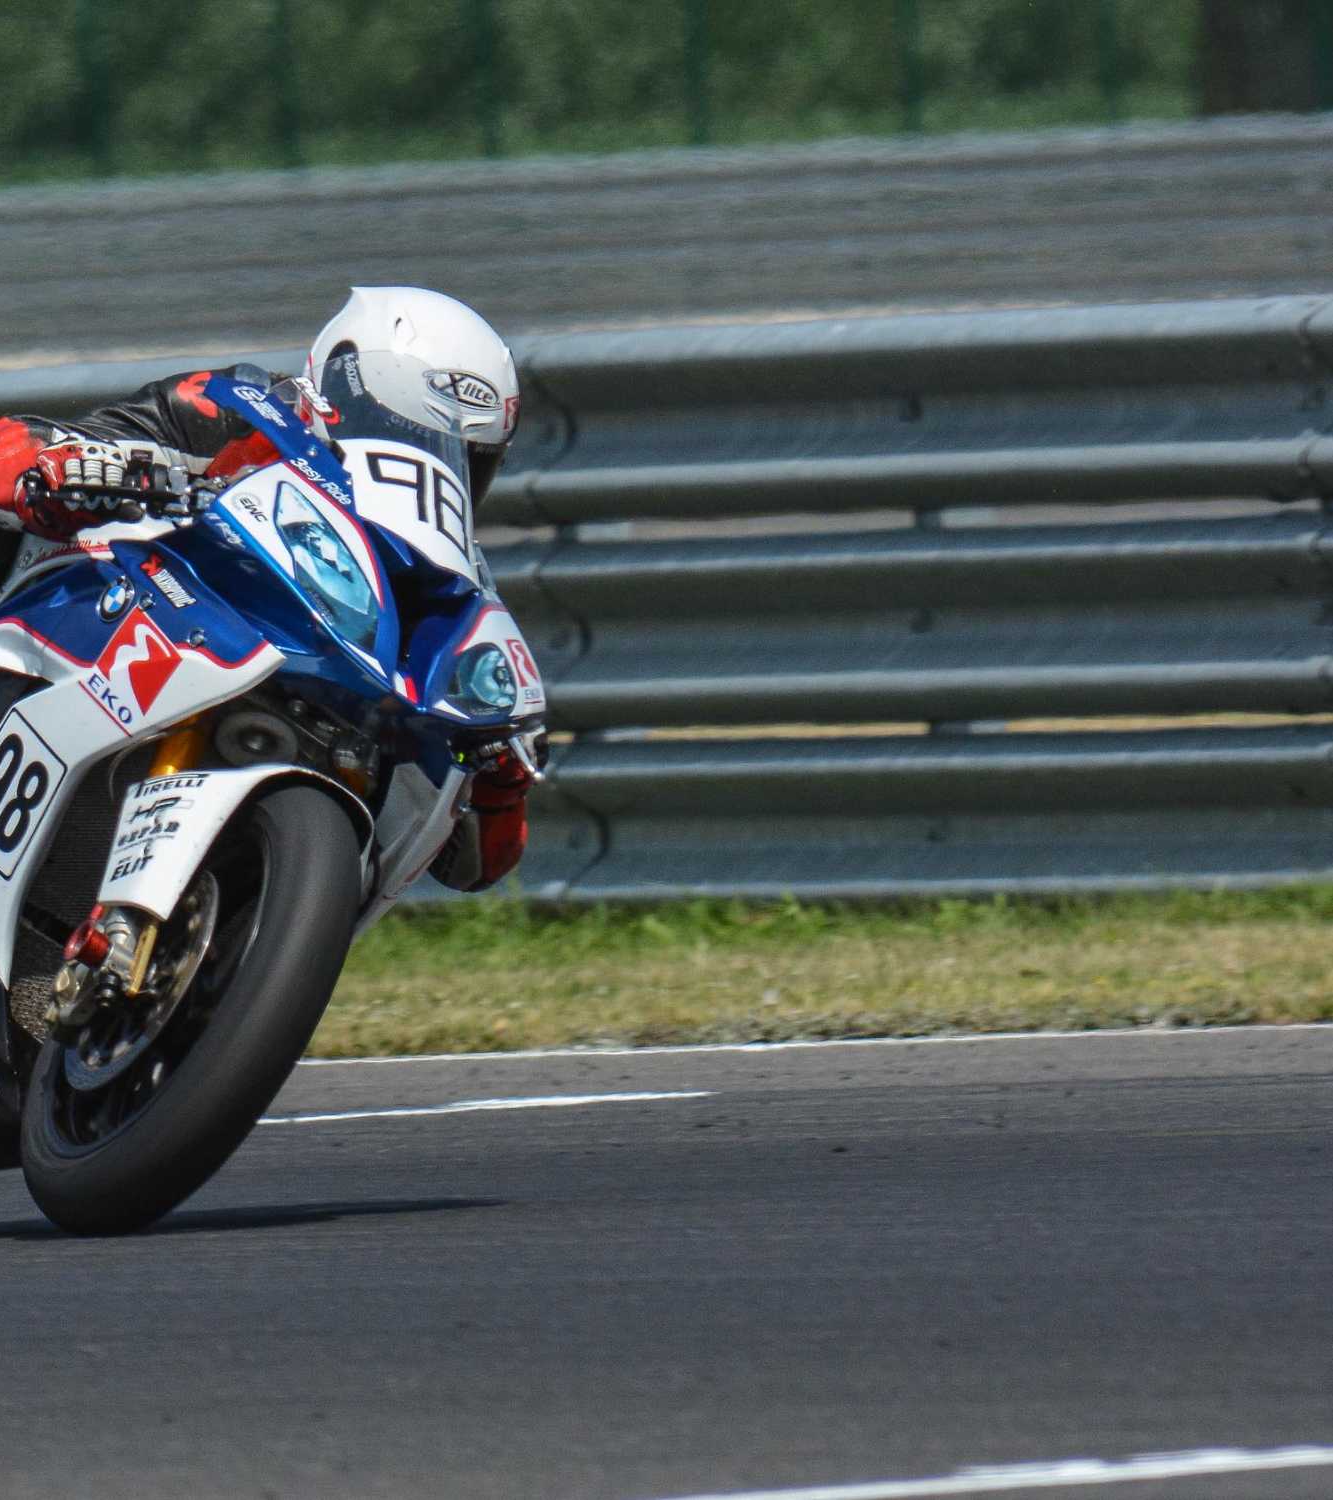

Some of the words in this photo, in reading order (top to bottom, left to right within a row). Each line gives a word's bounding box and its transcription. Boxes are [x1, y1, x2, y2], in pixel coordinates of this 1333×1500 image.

[437, 372, 494, 405] X-lite
[323, 480, 353, 506] Ride
[86, 672, 133, 725] EKO
[133, 772, 211, 799] PIRELLI
[109, 854, 155, 882] ELIT
